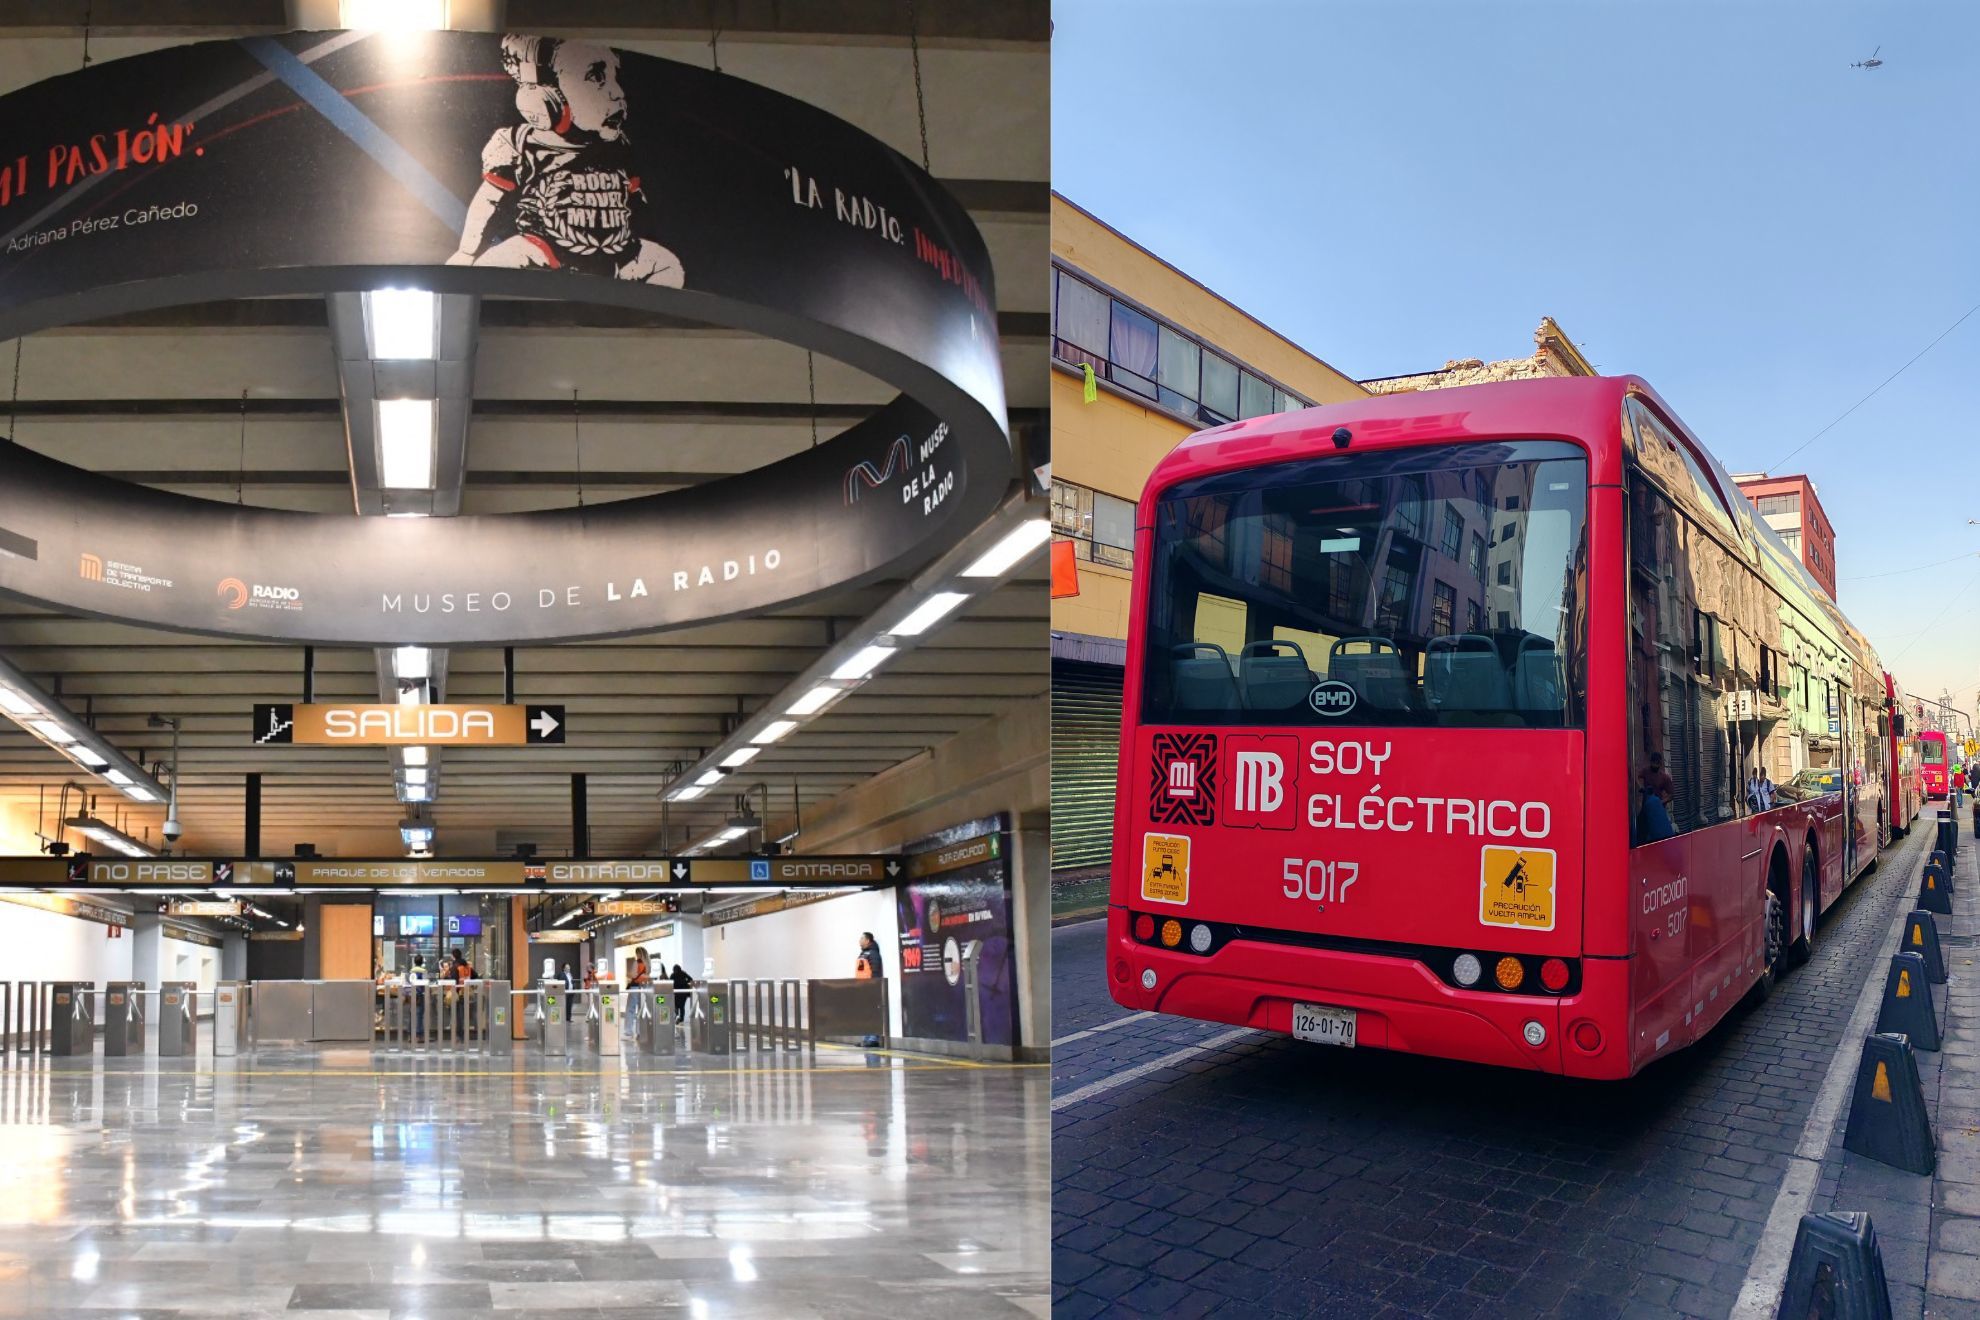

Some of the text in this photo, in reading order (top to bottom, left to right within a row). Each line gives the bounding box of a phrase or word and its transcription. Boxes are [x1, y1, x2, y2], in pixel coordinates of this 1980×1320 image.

[571, 172, 621, 191] ROCK
[567, 208, 597, 228] MY
[835, 187, 904, 245] RADIO:
[6, 201, 199, 254] Adriana Pérez Cañedo
[902, 464, 935, 504] DE LA
[923, 471, 953, 516] RADIO
[382, 549, 781, 613] MUSEO DE LA RADIO
[252, 584, 299, 600] RADIO
[1315, 691, 1351, 706] BYD
[324, 709, 494, 738] SALIDA
[1309, 740, 1392, 776] SOY
[1307, 783, 1551, 839] ELÉCTRICO
[94, 864, 207, 880] NO PASE
[312, 868, 485, 877] PARQUE DE LOS VENADOS
[553, 864, 663, 879] ENTRADA
[782, 864, 872, 877] ENTRADA
[1283, 857, 1359, 903] 5017
[171, 902, 193, 913] NO
[597, 902, 663, 912] NO PASE
[1493, 902, 1541, 912] PRECAUCIÓN
[1517, 912, 1546, 920] AMPLIA
[1667, 907, 1688, 937] 5017
[1296, 1015, 1353, 1038] 126-01-70
